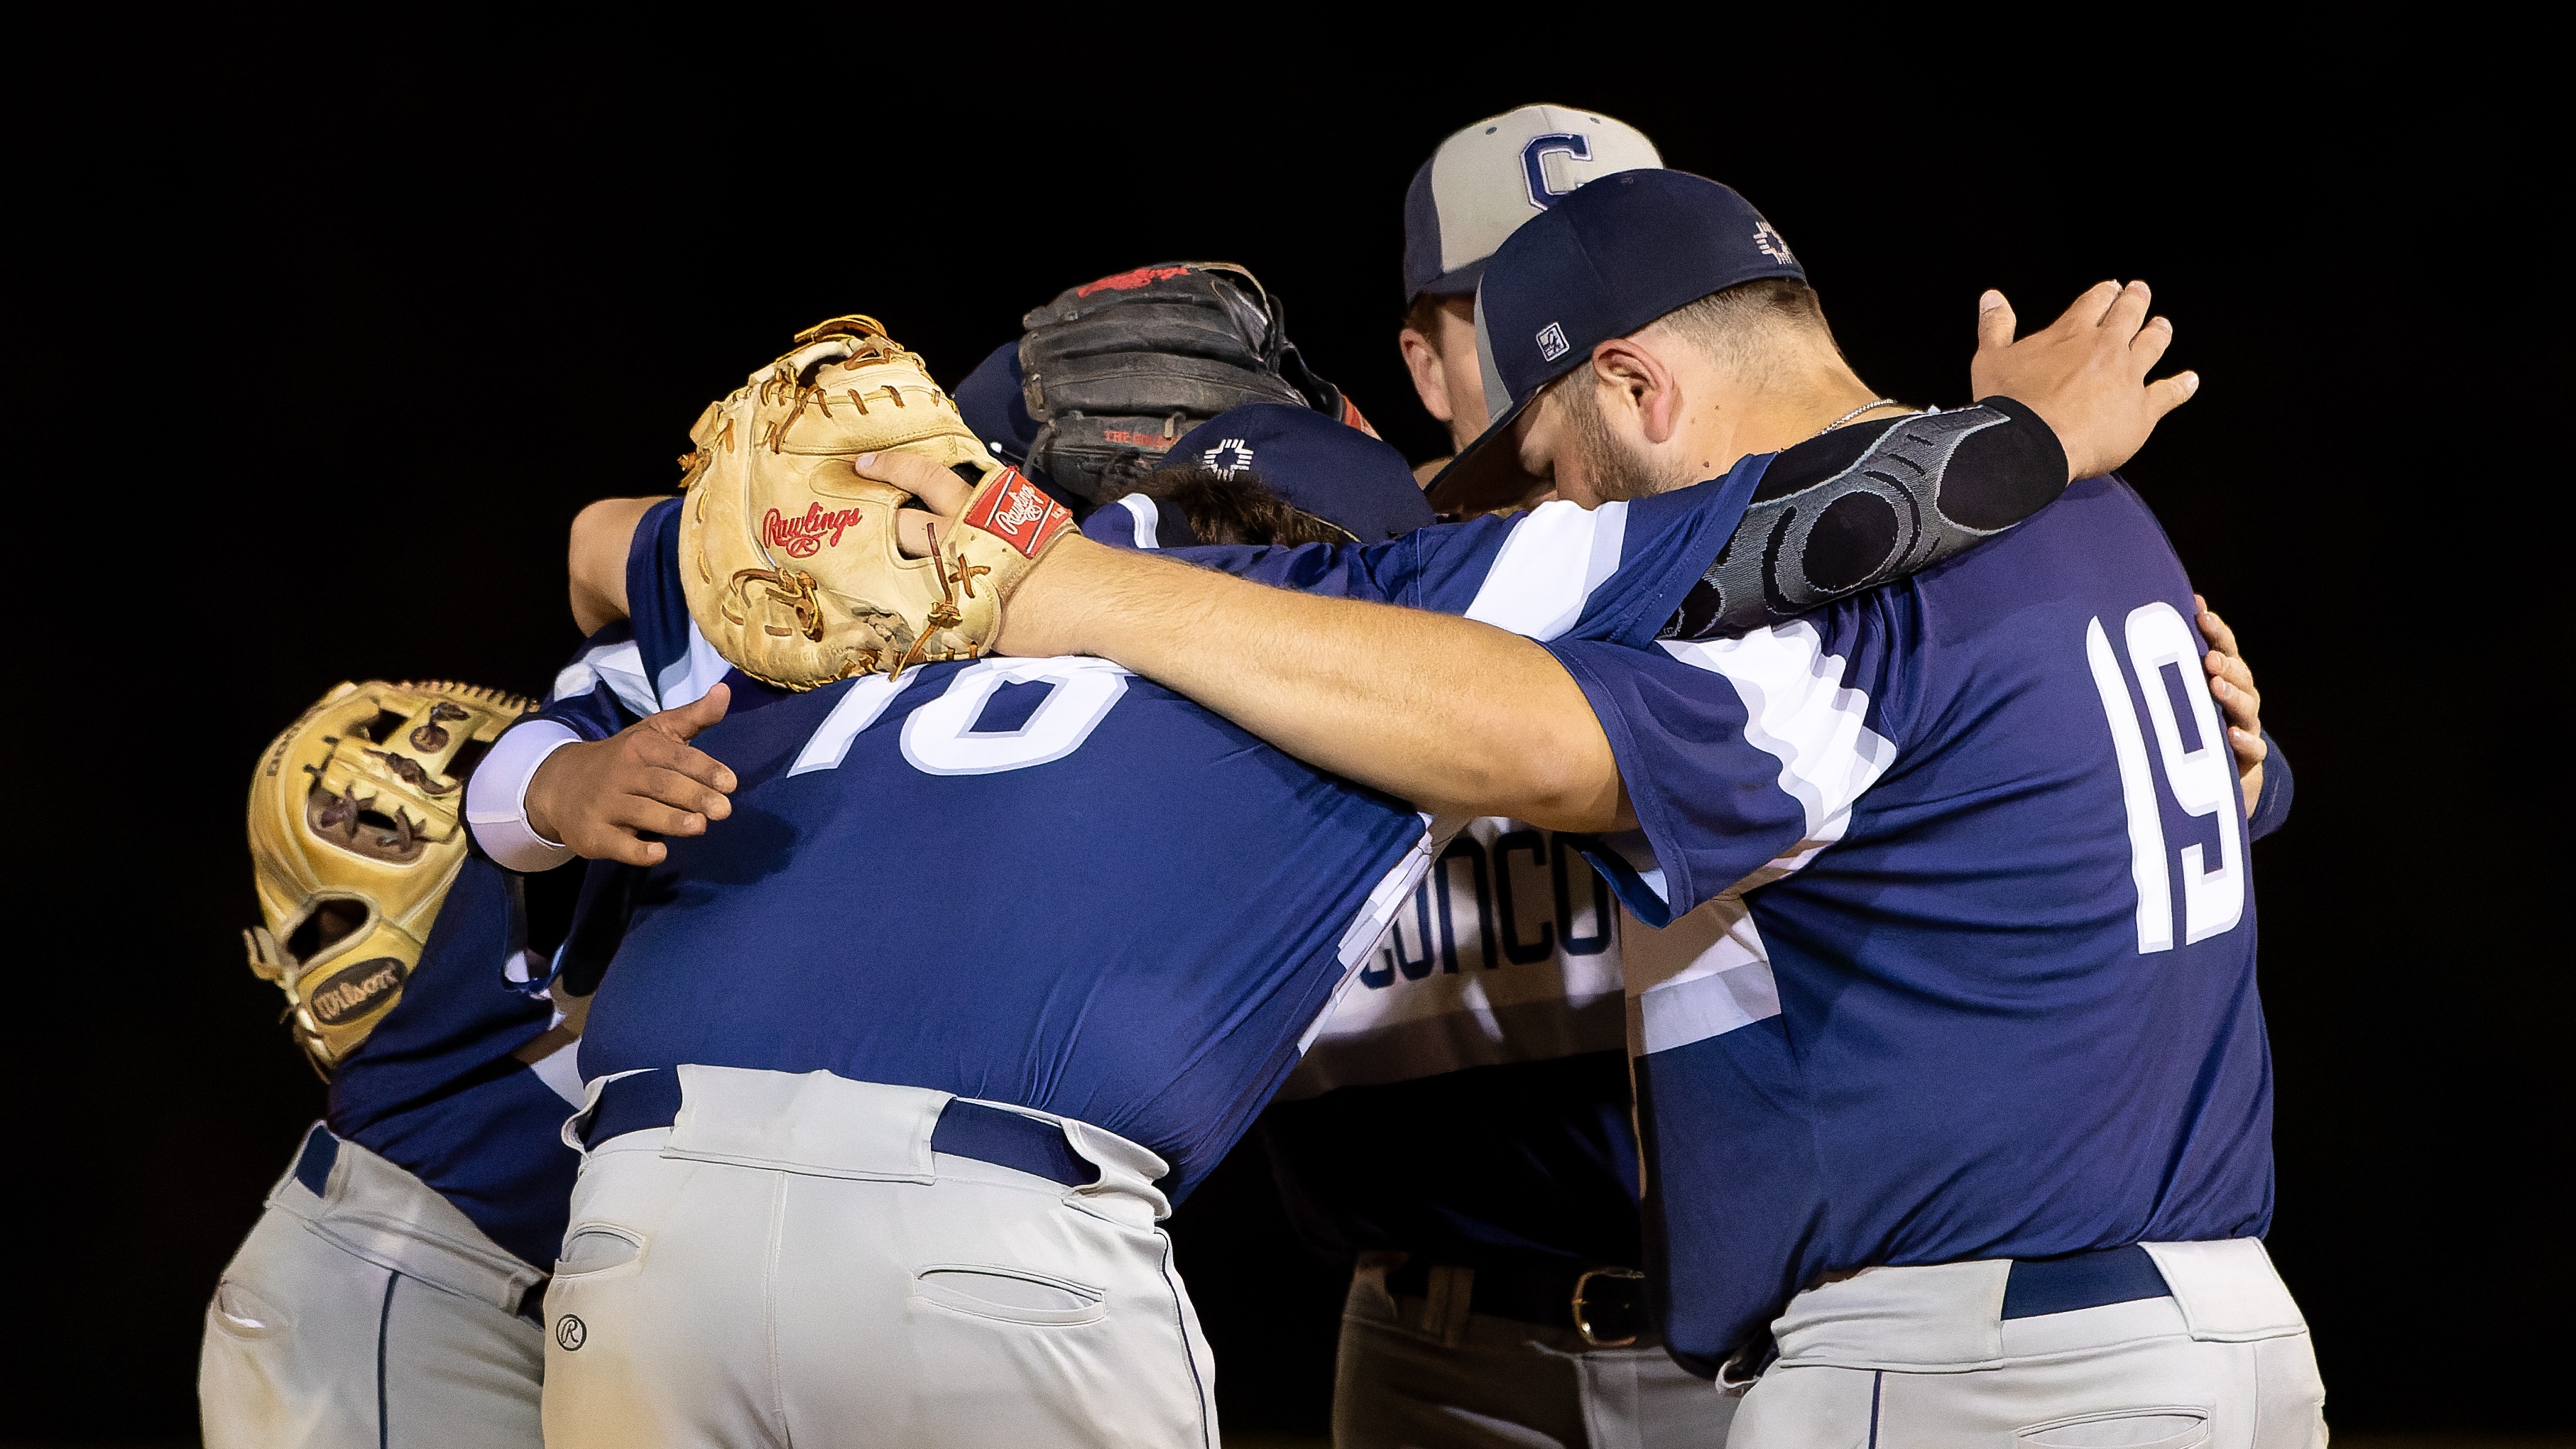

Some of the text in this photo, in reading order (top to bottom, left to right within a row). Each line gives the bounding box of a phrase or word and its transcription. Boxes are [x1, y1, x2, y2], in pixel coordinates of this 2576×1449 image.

[1519, 133, 1593, 211] C
[763, 501, 863, 549] Rawlings
[2086, 601, 2245, 954] 19
[314, 961, 398, 1019] Wilson
